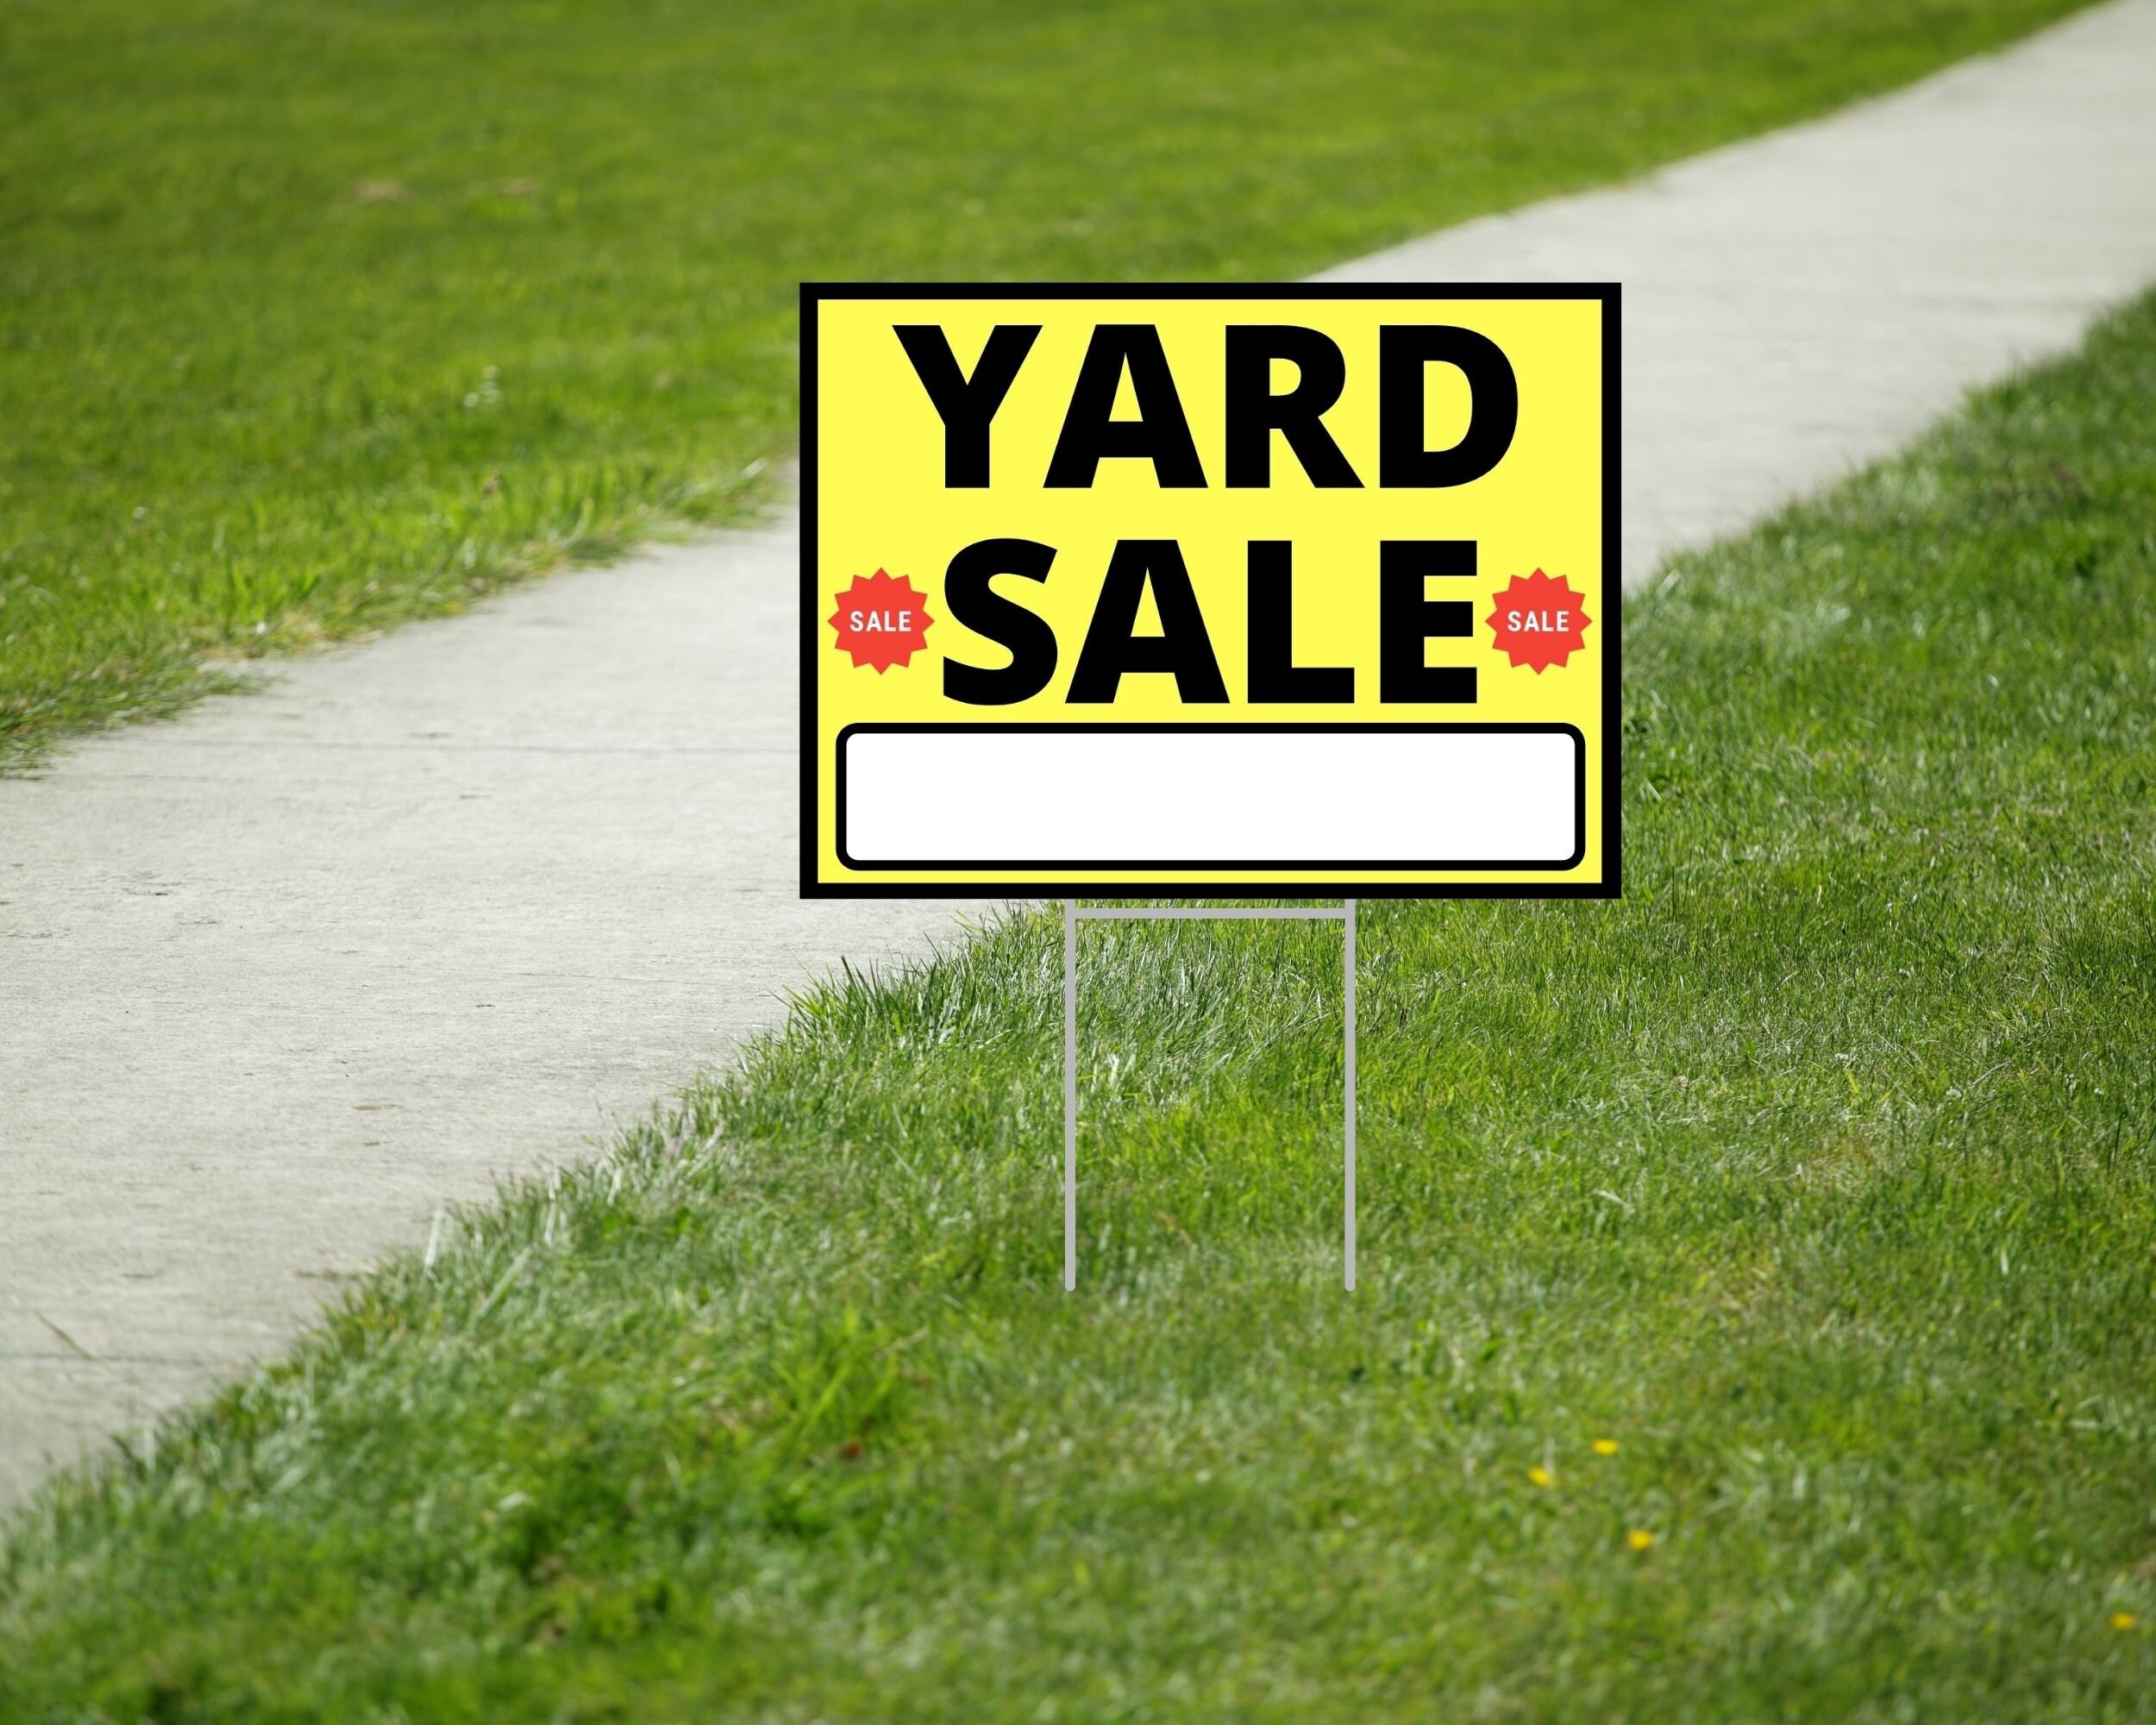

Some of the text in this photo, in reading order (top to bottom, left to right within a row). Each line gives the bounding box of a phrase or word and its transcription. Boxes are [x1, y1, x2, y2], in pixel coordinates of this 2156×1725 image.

[892, 323, 1519, 489] YARD
[849, 611, 912, 632] SALE
[943, 537, 1477, 706] SALE
[1507, 611, 1569, 632] SALE
